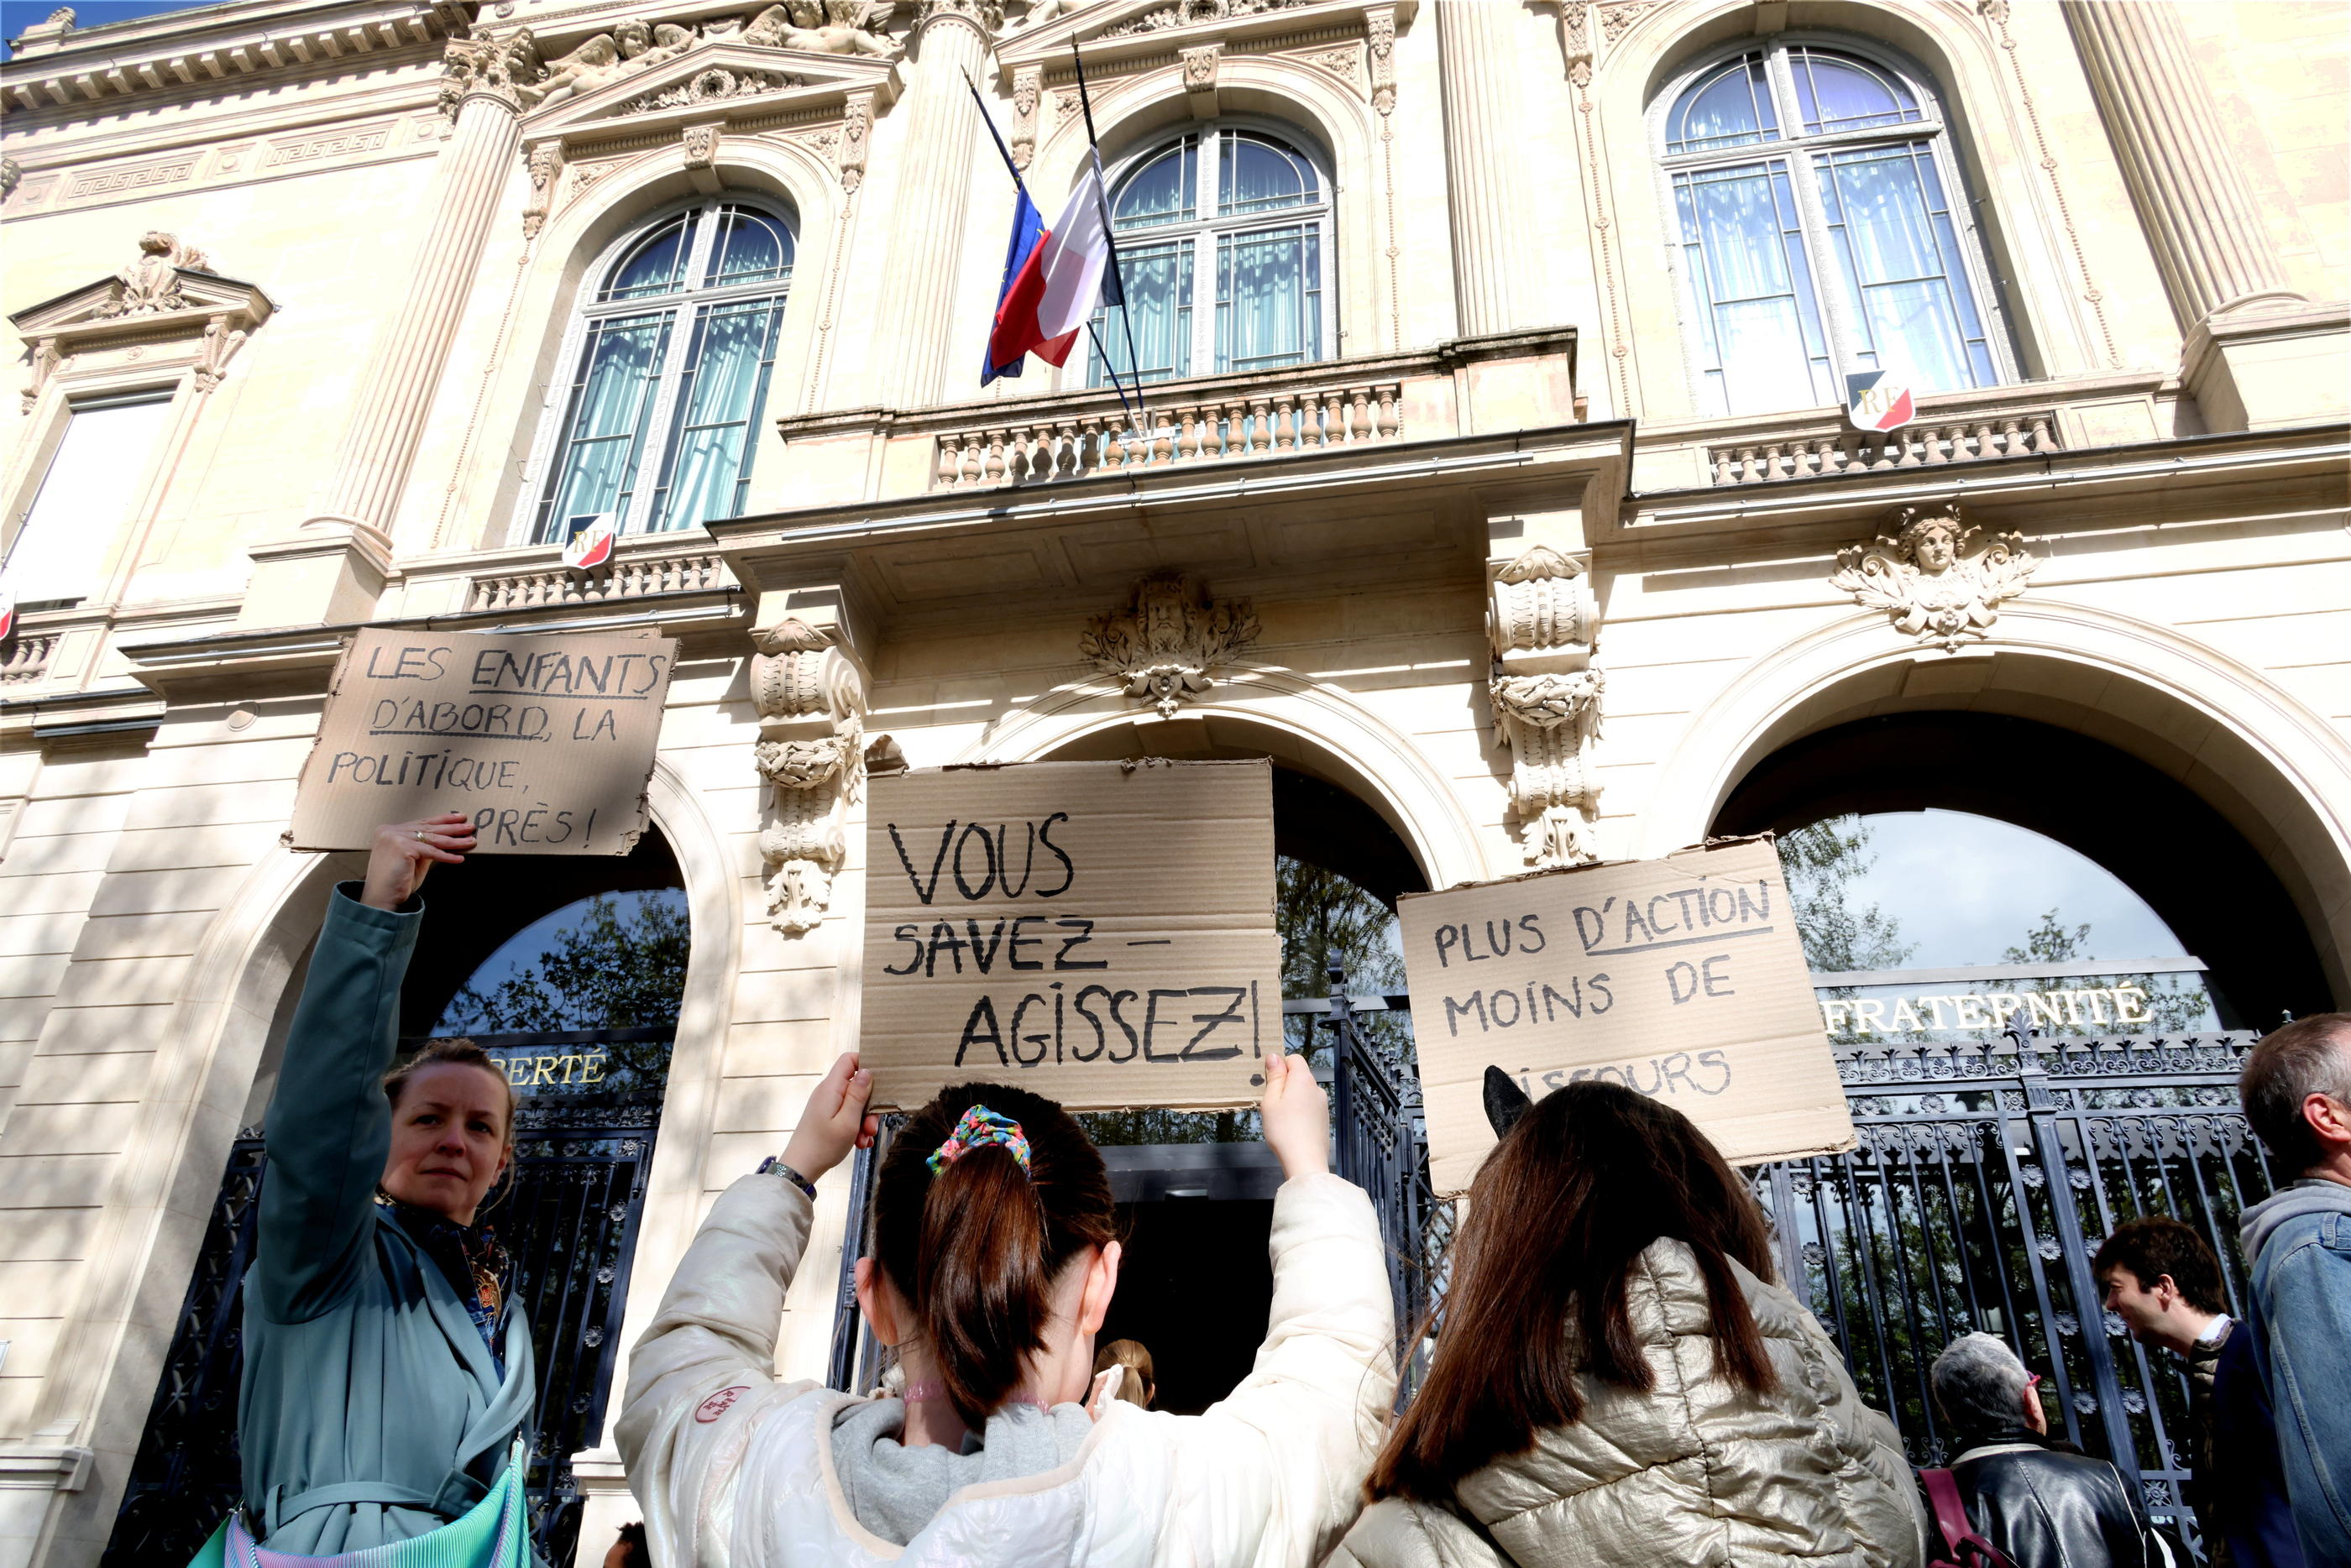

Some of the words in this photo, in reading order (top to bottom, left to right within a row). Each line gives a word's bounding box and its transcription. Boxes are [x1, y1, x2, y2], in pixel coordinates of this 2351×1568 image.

[366, 646, 452, 681] LES
[472, 649, 667, 694] ENFANTS
[372, 695, 552, 742] D'ABORD,
[573, 708, 616, 740] LA
[450, 802, 597, 849] PRÈS!
[888, 812, 1074, 905] VOUS
[883, 914, 1107, 978] SAVEZ
[1434, 913, 1546, 968] PLUS
[1572, 875, 1769, 952] D'ACTION
[1443, 971, 1614, 1037] MOINS
[1665, 954, 1735, 1005] DE
[1820, 980, 2154, 1034] FRATERNITÉ
[954, 980, 1265, 1086] AGISSEZ!
[490, 1047, 606, 1086] ERTÉ
